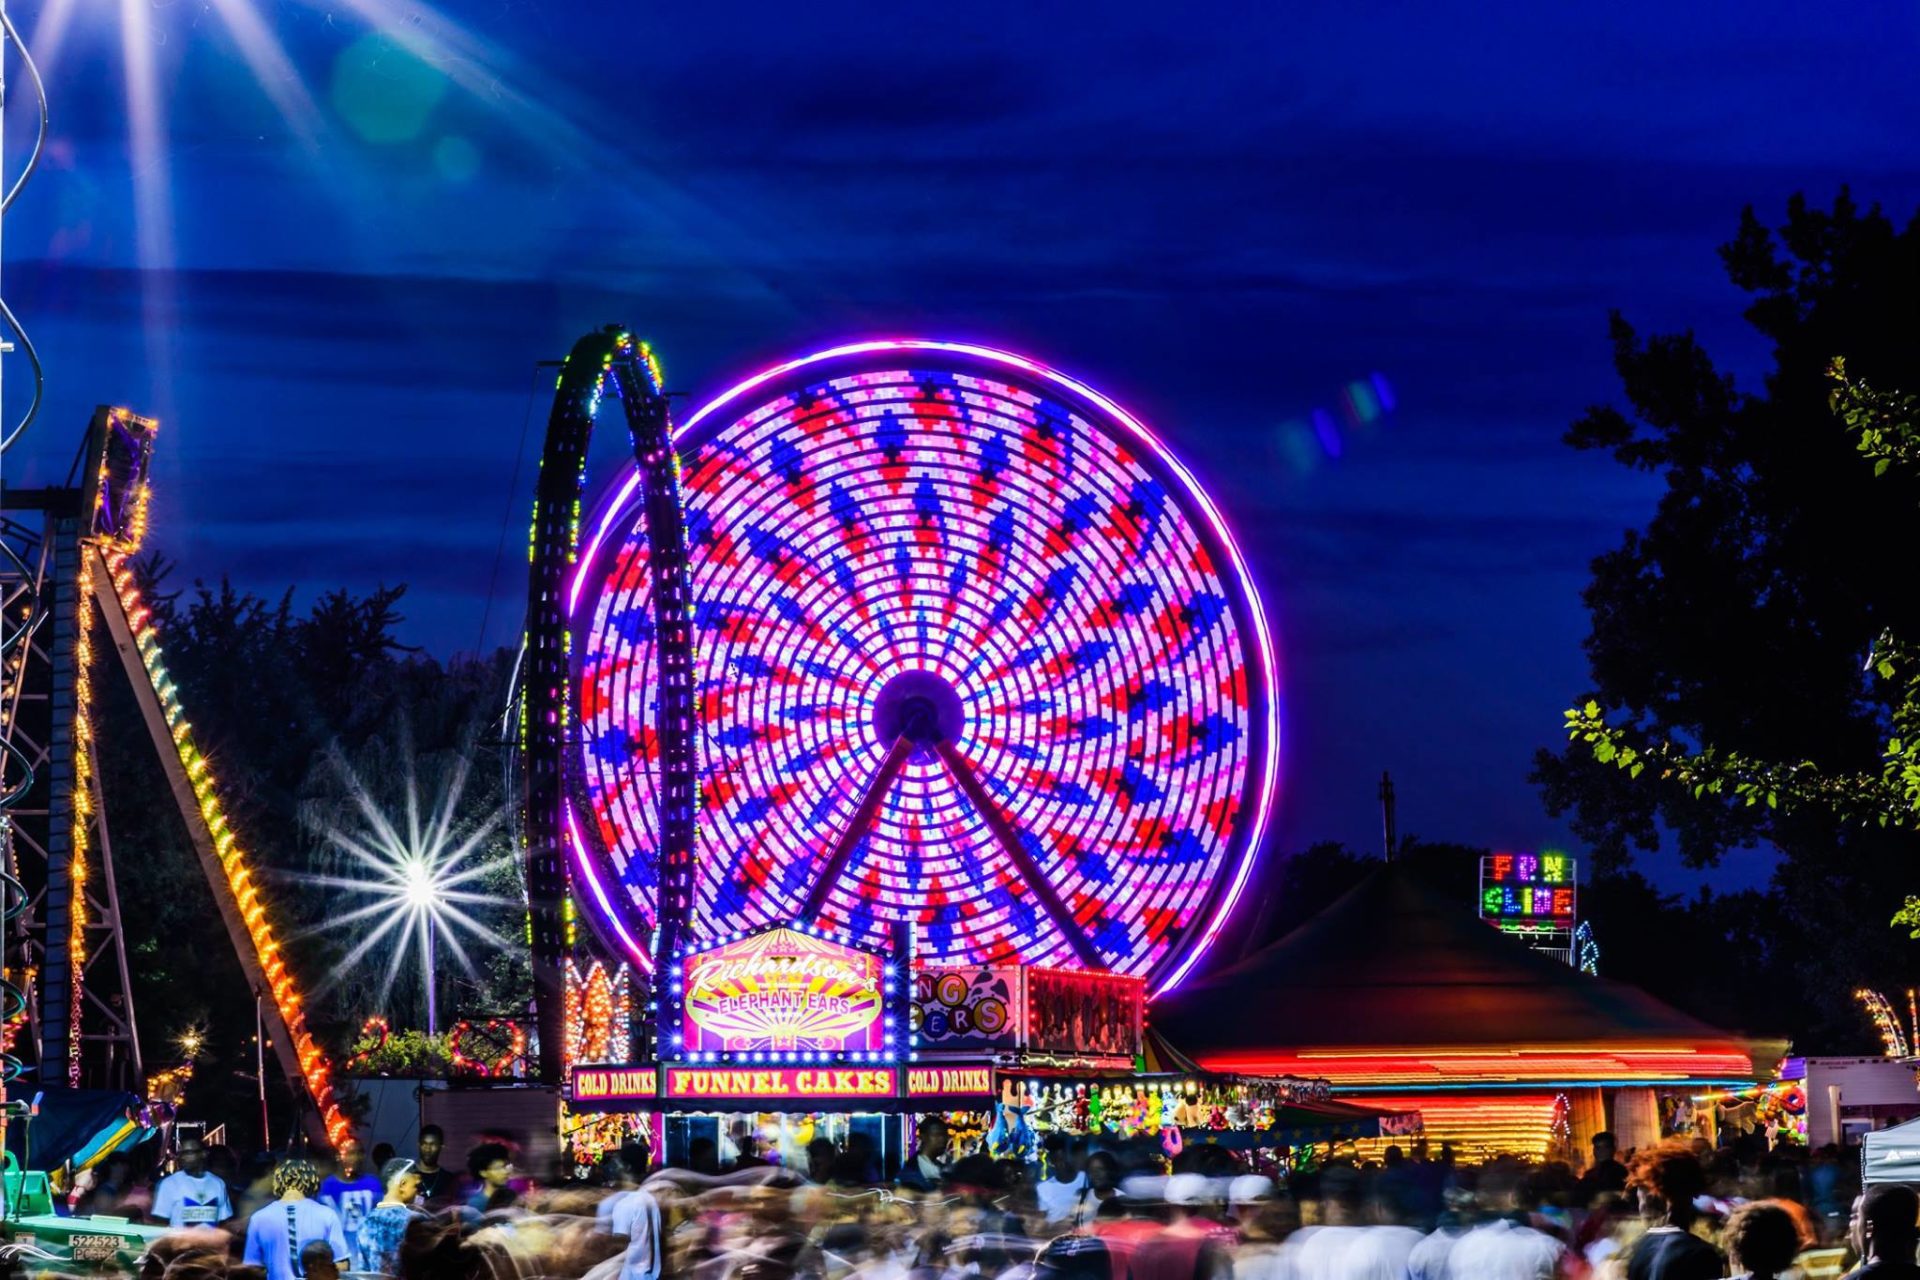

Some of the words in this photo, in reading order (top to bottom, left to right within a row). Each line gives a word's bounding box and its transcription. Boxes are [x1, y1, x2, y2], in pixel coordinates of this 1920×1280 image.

[1484, 887, 1572, 914] GLIDE
[689, 950, 879, 998] Richardson's
[718, 990, 805, 1015] ELEPHANT
[807, 993, 850, 1015] EARS
[578, 1073, 608, 1096] COLD
[610, 1071, 656, 1095] DRINKS
[674, 1071, 789, 1095] FUNNEL
[796, 1070, 891, 1094] CAKES
[908, 1070, 940, 1093] COLD
[942, 1069, 990, 1092] DRINKS
[72, 1235, 120, 1248] 522523
